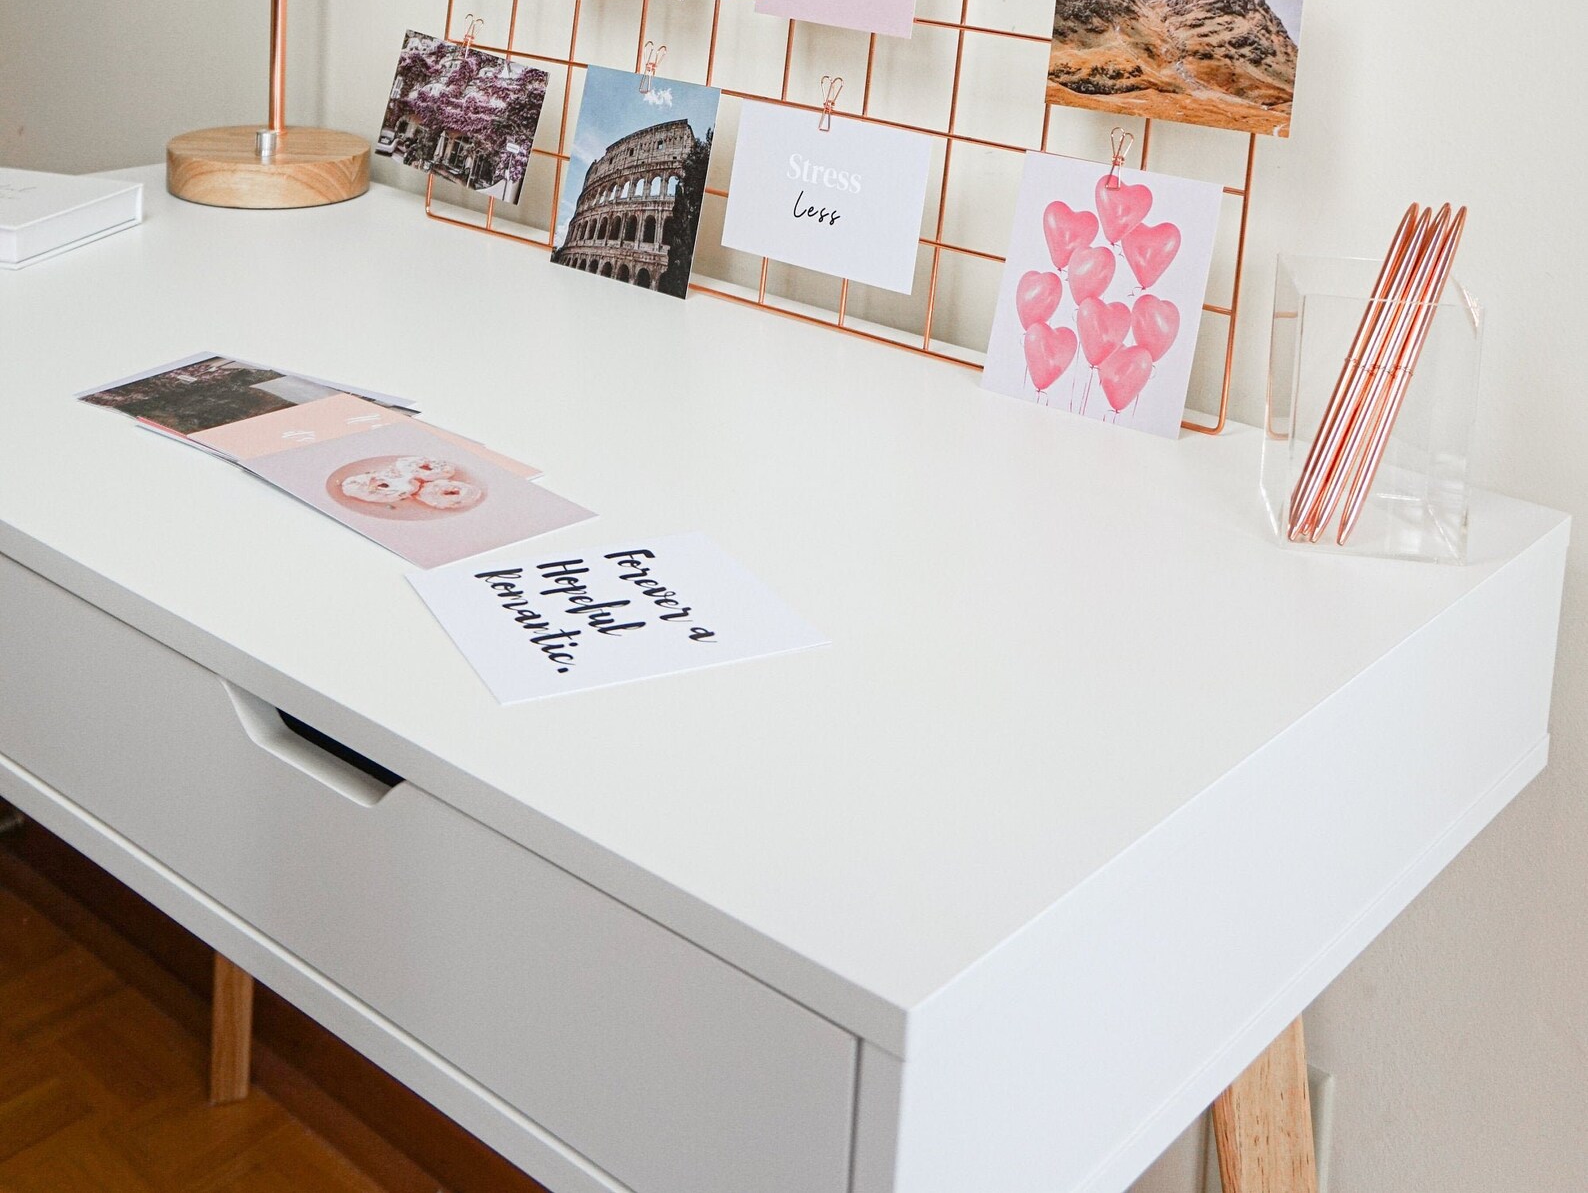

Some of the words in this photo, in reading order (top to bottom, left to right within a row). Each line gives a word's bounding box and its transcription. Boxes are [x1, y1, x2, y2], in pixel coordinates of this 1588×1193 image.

[787, 153, 861, 194] Stress
[474, 568, 581, 674] Romantic.
[536, 559, 647, 637] Hopeful
[604, 549, 693, 622] Forever
[688, 626, 719, 644] a
